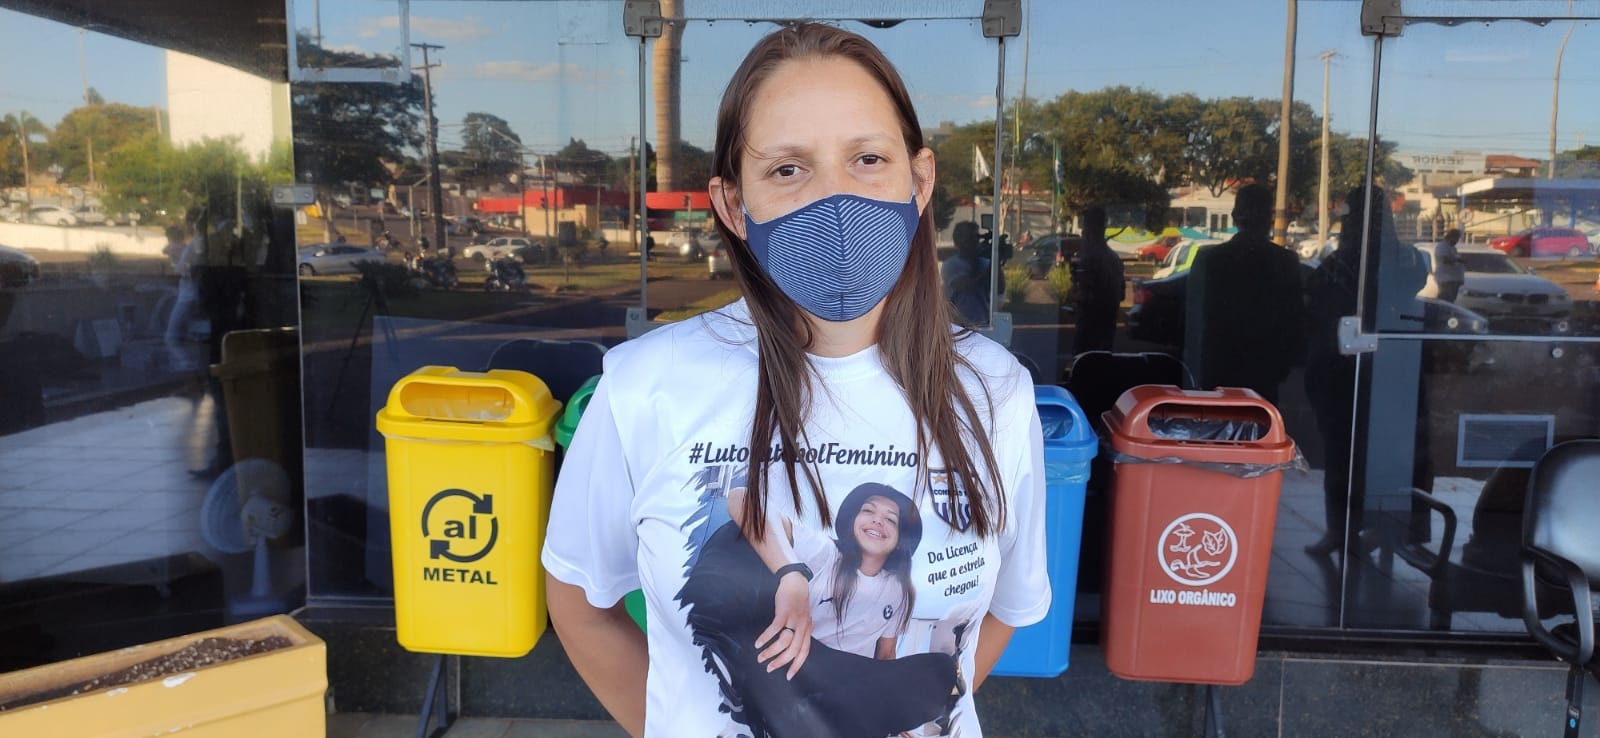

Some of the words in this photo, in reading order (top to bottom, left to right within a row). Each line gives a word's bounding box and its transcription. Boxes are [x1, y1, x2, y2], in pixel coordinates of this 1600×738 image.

[688, 442, 919, 468] #LutotbolFeminino
[927, 551, 944, 564] Da
[945, 542, 978, 560] Licença
[423, 567, 498, 585] METAL
[927, 570, 947, 585] que
[950, 567, 957, 577] a
[958, 556, 985, 575] estrela
[944, 574, 979, 597] chegou!
[1150, 589, 1176, 604] LIXO
[1177, 589, 1237, 607] ORGÂNICO
